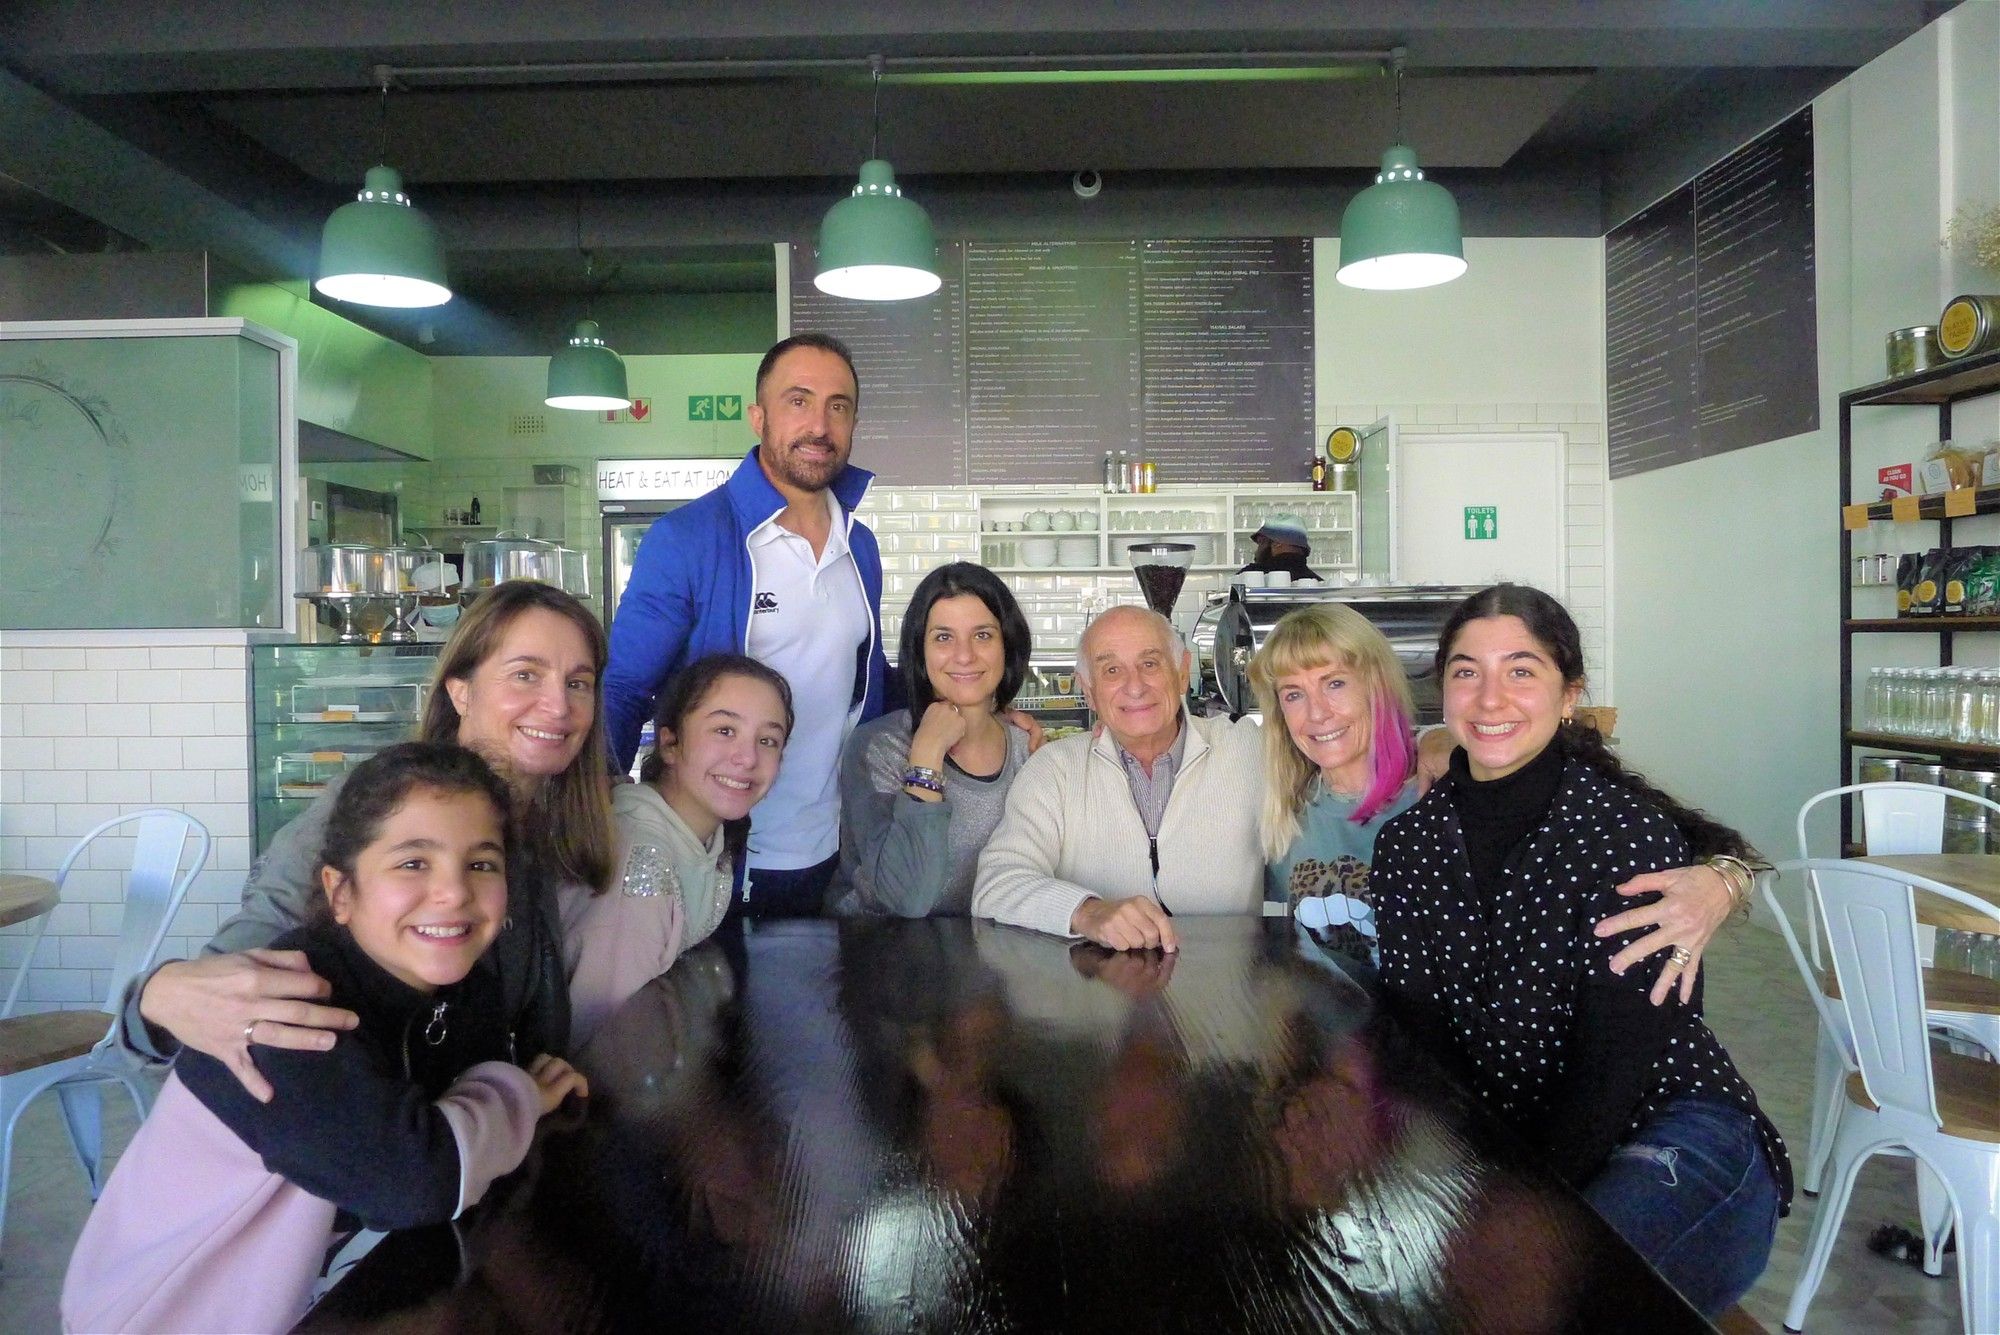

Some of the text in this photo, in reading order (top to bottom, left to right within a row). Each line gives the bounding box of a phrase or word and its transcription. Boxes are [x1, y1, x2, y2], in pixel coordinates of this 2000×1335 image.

[599, 470, 730, 489] HEAT & EAT AT HO
